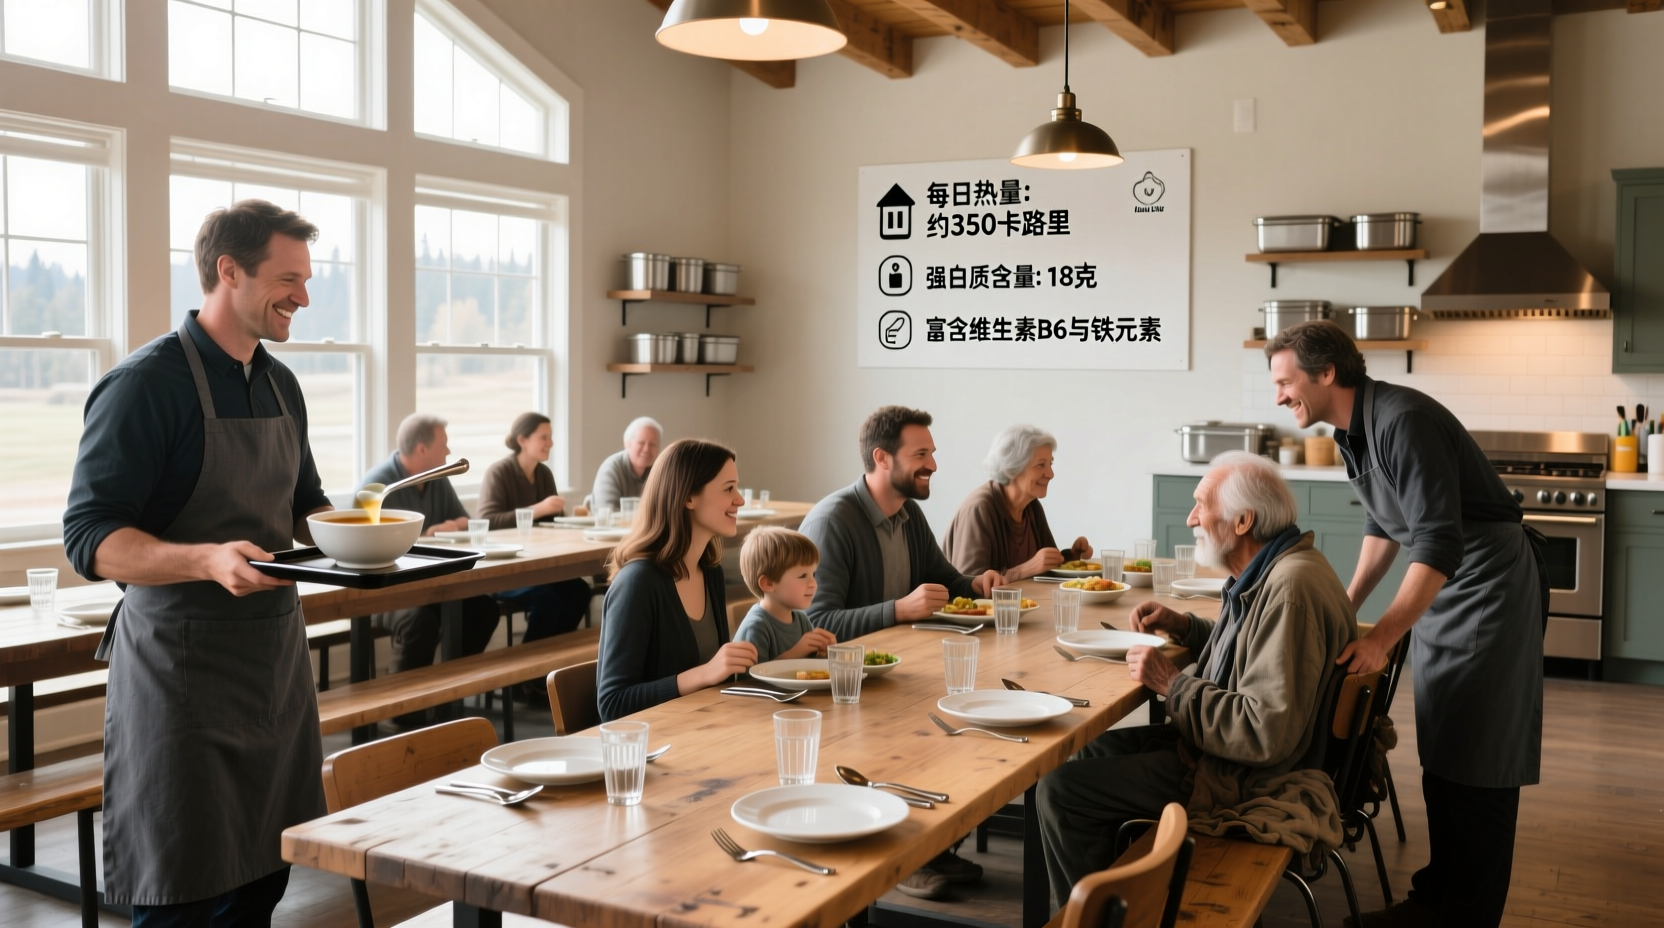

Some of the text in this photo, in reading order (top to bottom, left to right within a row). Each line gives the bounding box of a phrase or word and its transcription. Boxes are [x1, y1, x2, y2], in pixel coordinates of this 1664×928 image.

[926, 209, 1071, 239] 约350卡路里
[926, 315, 1162, 343] 富含维生素B6与铁元素
